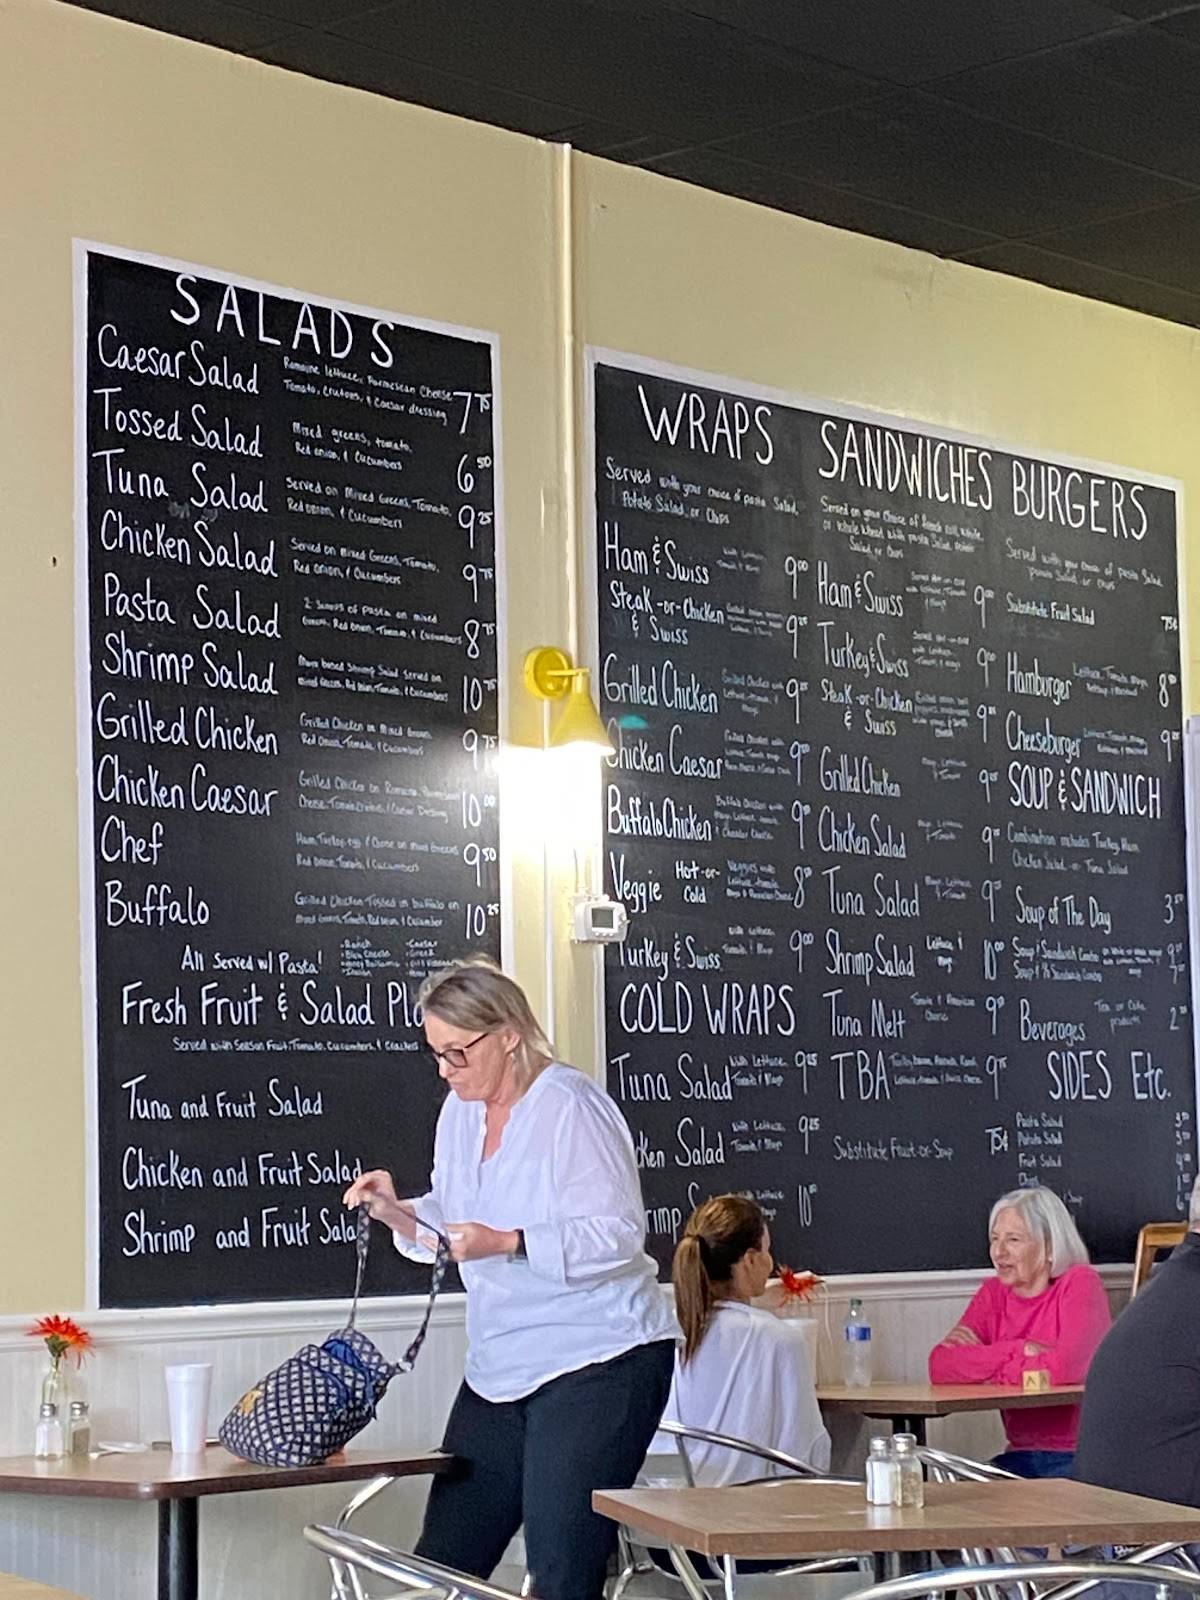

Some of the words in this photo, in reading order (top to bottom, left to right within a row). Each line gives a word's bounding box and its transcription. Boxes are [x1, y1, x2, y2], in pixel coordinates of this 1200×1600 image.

[170, 273, 395, 369] SALADS
[98, 324, 186, 379] Caesar
[188, 340, 259, 394] Salad
[93, 387, 182, 441] Tossed
[191, 404, 263, 457] Salad
[409, 404, 447, 426] dressing
[92, 448, 169, 498] Tuna
[191, 462, 268, 513] Salad
[606, 457, 651, 484] Served
[638, 384, 775, 464] WRAPS
[819, 419, 993, 511] SANDWICHES
[1013, 459, 1148, 540] BURGERS
[286, 477, 322, 493] Served
[345, 487, 374, 502] Mixed
[101, 509, 190, 564] Chicken
[194, 520, 278, 577] Salad
[605, 522, 648, 575] Ham
[665, 540, 709, 584] Swiss
[105, 573, 176, 624] Pasta
[193, 584, 281, 638] Salad
[610, 580, 653, 613] Steak
[683, 597, 724, 624] Chicken
[818, 560, 852, 608] Ham
[864, 571, 903, 617] Swiss
[650, 615, 690, 644] Swiss
[1072, 607, 1094, 625] Salad
[102, 630, 193, 685] Shrimp
[202, 642, 278, 694] Salad
[817, 621, 872, 678] Turkey
[876, 633, 909, 677] Swiss
[604, 653, 657, 706] Grilled
[662, 660, 718, 713] Chicken
[821, 679, 852, 704] Steak
[875, 687, 912, 713] Chicken
[1008, 652, 1072, 705] Hamburger
[97, 692, 189, 745] Grilled
[195, 707, 277, 755] Chicken
[865, 708, 897, 735] Swiss
[1006, 710, 1081, 765] Cheeseburger
[605, 717, 664, 776] Chicken
[670, 725, 722, 779] Caesar
[820, 746, 860, 792] Grilled
[862, 756, 900, 797] Chicken
[98, 754, 184, 809] Chicken
[191, 763, 278, 816] Caesar
[1009, 761, 1053, 809] SOUP
[1071, 767, 1160, 819] SANDWICH
[608, 784, 662, 836] Buffalo
[662, 798, 711, 841] Chicken
[818, 805, 872, 855] Chicken
[869, 814, 906, 858] Salad
[101, 815, 163, 865] Chef
[105, 880, 209, 926] Buffalo
[609, 851, 662, 913] Veggie
[676, 861, 699, 879] Hot
[684, 885, 706, 903] Cold
[822, 866, 865, 915] Tuna
[874, 873, 919, 917] Salad
[1016, 886, 1045, 931] Soup
[1062, 895, 1084, 925] The
[1089, 896, 1111, 934] Day
[182, 945, 204, 971] All
[213, 953, 253, 971] Served
[279, 950, 321, 974] Pasta!
[684, 936, 722, 970] Swiss
[826, 929, 873, 986] Shrimp
[875, 934, 915, 977] Salad
[123, 981, 186, 1024] Fresh
[202, 982, 263, 1025] Fruit
[278, 983, 288, 1020] &
[300, 980, 375, 1025] Salad
[620, 980, 692, 1033] COLD
[702, 983, 795, 1035] WRAPS
[823, 989, 862, 1036] Tuna
[872, 999, 906, 1038] Melt
[1020, 999, 1085, 1046] Beverages
[173, 1037, 207, 1051] Served
[122, 1075, 172, 1120] Tuna
[181, 1095, 209, 1119] and
[216, 1091, 256, 1118] Fruit
[268, 1078, 322, 1117] Salad
[610, 1053, 671, 1102] Tuna
[678, 1053, 734, 1100] Salad
[831, 1050, 892, 1100] TBA
[1047, 1050, 1111, 1100] SIDES
[1131, 1051, 1171, 1100] Etc.
[675, 1117, 724, 1166] Salad
[834, 1136, 888, 1160] Substitute
[123, 1147, 203, 1190] Chicken
[213, 1158, 248, 1187] and
[258, 1151, 303, 1186] Fruit
[307, 1150, 363, 1186] Salad
[123, 1209, 195, 1256] Shrimp
[216, 1217, 250, 1249] and
[262, 1207, 310, 1247] Fruit
[318, 1207, 358, 1245] Sala
